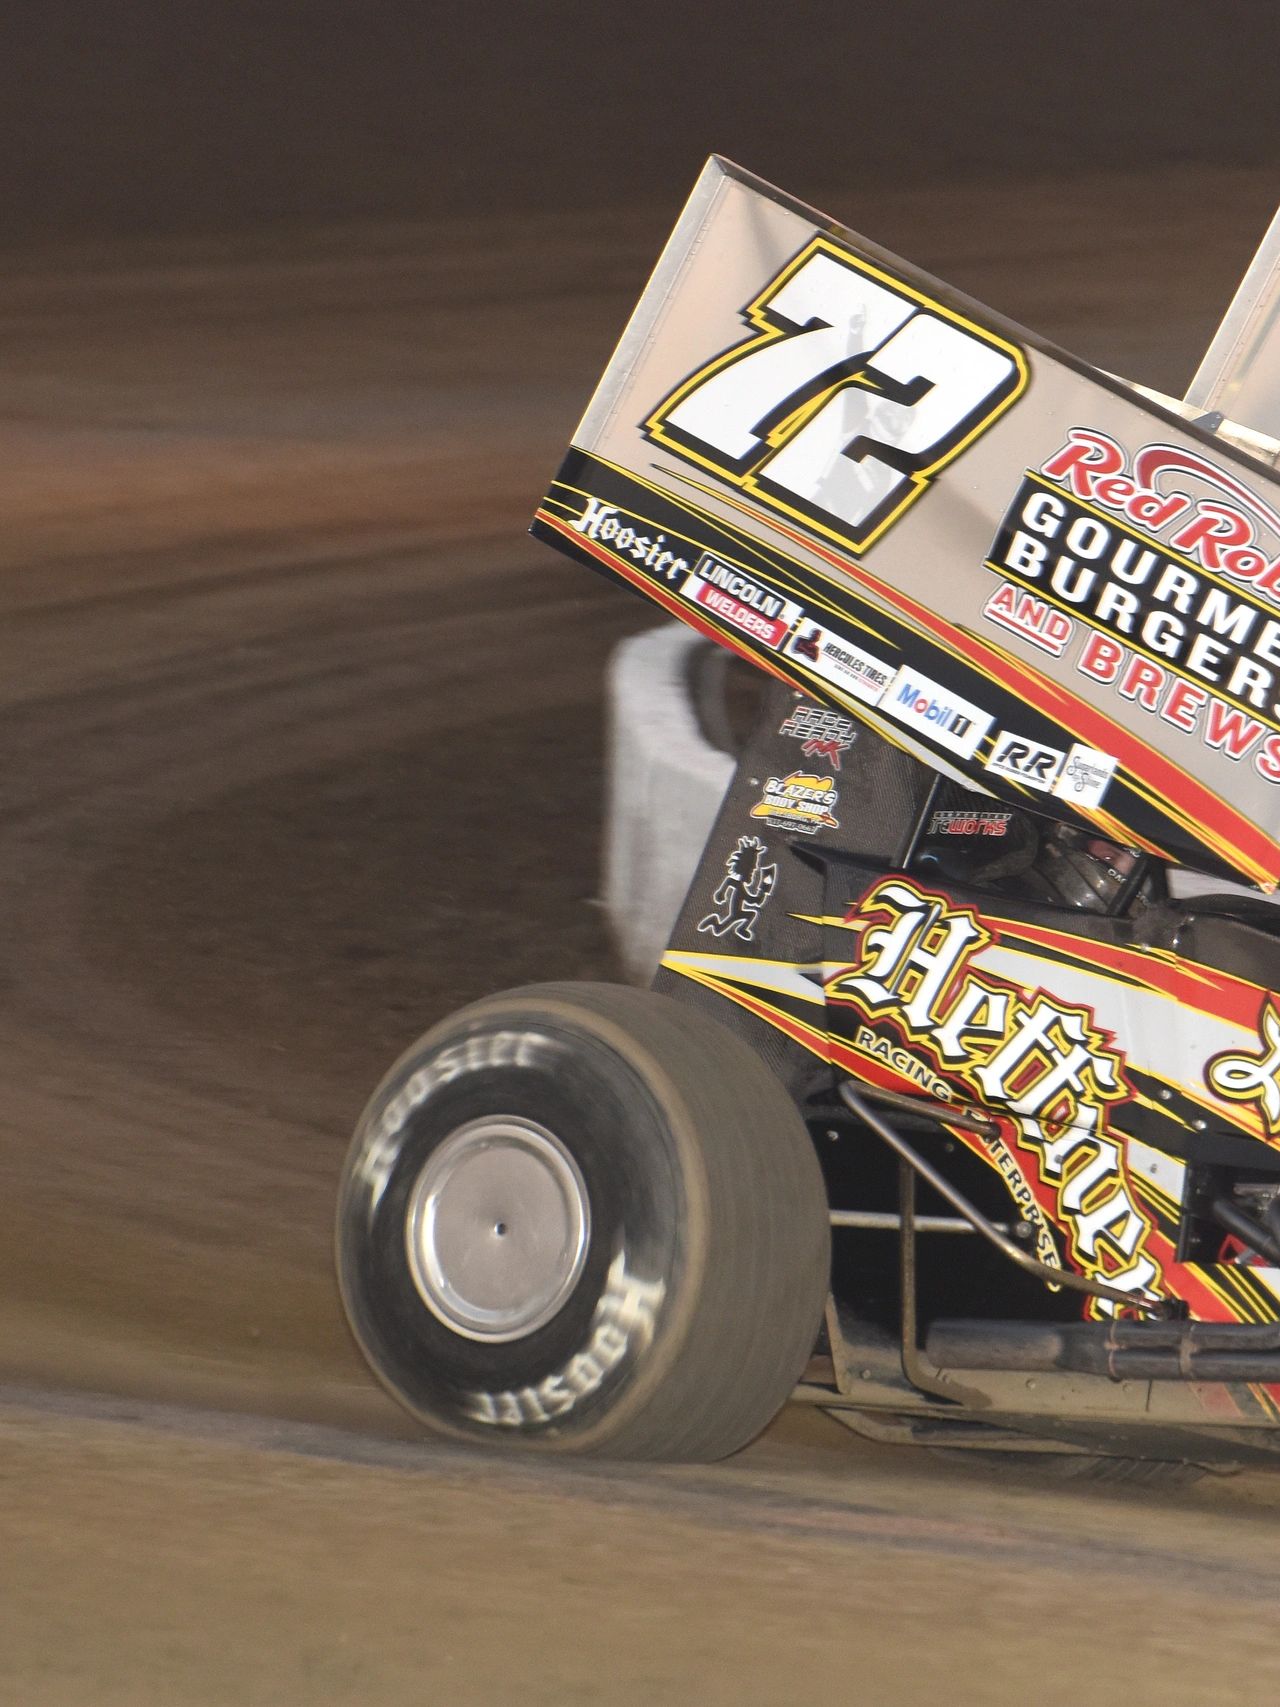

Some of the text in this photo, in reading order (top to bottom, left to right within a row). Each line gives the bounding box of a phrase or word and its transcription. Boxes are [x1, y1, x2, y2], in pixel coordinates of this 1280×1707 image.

[658, 246, 1018, 536] 72
[1041, 427, 1190, 531] Red
[568, 497, 688, 580] Hoosier
[699, 558, 782, 617] LINCOLN
[704, 588, 776, 640] WELDERS
[990, 584, 1072, 645] AND
[823, 642, 865, 672] HERCULES
[862, 664, 888, 686] TIRES
[895, 681, 974, 739] Mobil 1
[796, 800, 829, 815] SHOP
[857, 1026, 953, 1103] RACING
